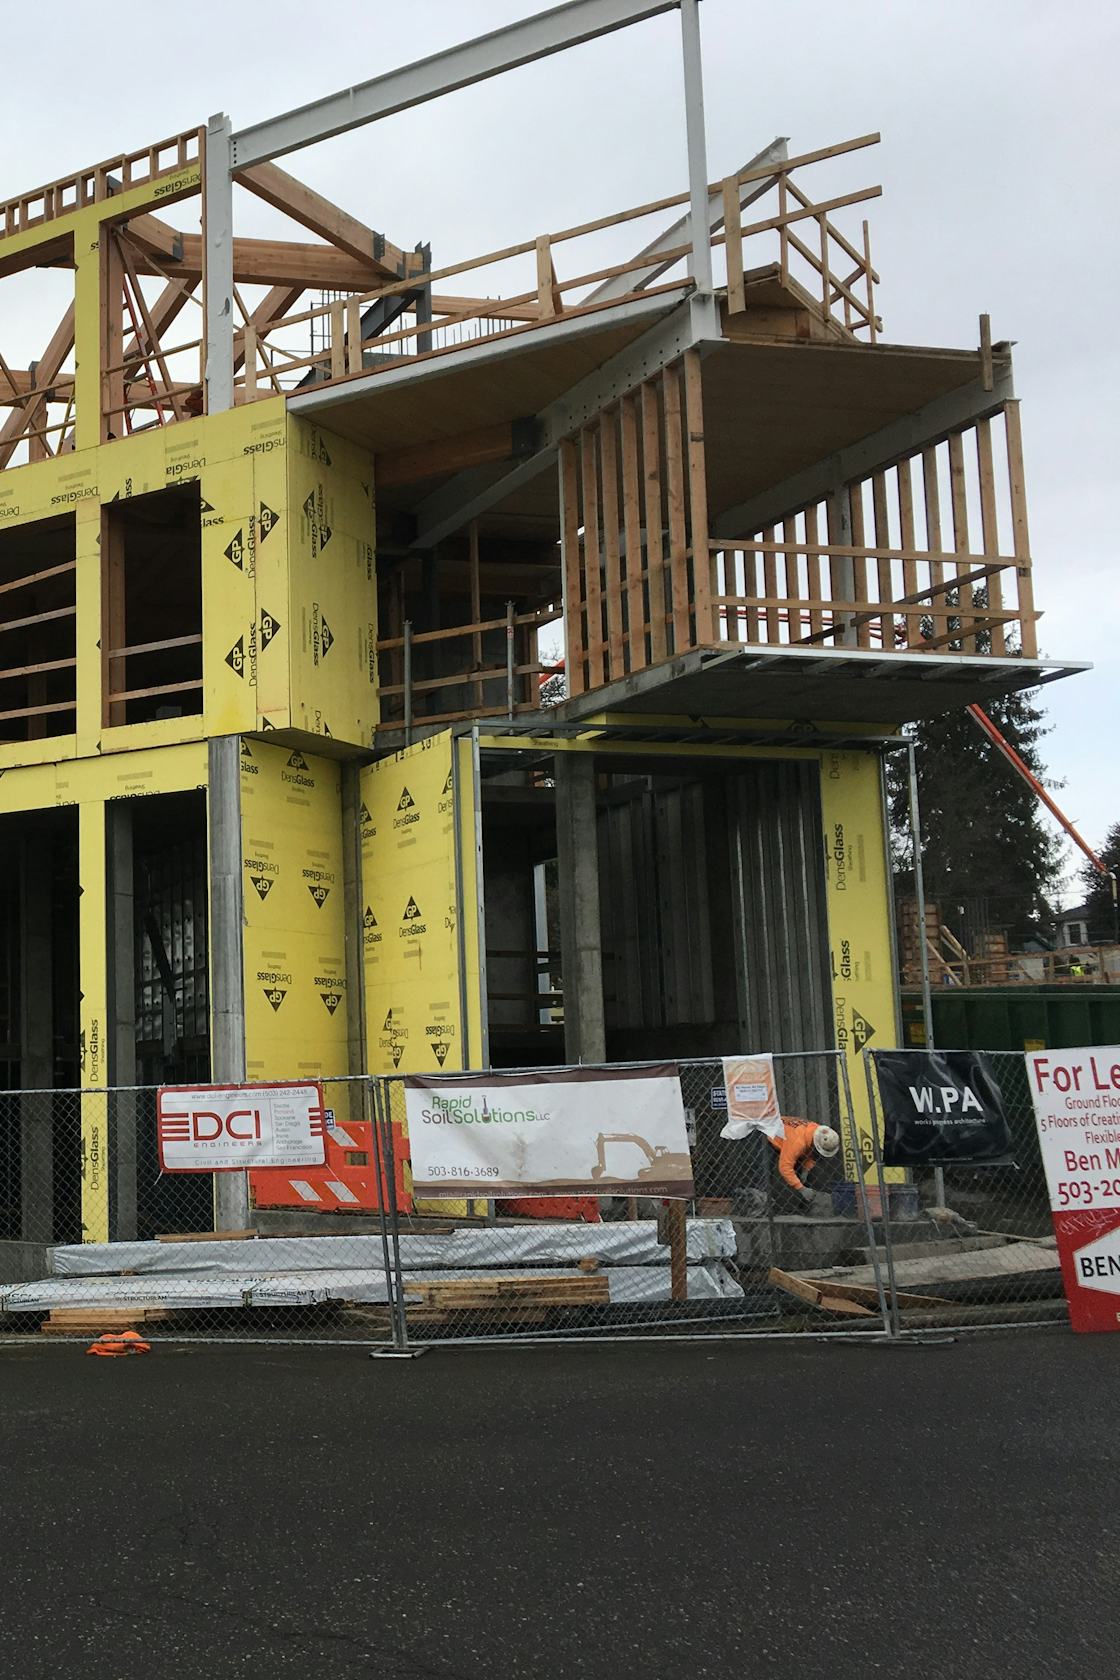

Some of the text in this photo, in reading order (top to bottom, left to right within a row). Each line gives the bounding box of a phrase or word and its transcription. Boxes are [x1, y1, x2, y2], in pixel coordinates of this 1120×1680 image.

[51, 486, 100, 505] DensGlass
[261, 509, 272, 531] GP
[232, 540, 241, 563] GP
[248, 515, 256, 579] DensGlass
[262, 616, 272, 639] GP
[322, 625, 329, 649] GP
[232, 646, 243, 670] GP
[291, 755, 304, 766] GP
[281, 770, 315, 788] DensGlass
[400, 796, 411, 807] GP
[393, 812, 420, 829] DensGlass
[836, 823, 846, 891] DensGlass
[244, 859, 279, 875] DensGlass
[302, 869, 335, 884] DensGlass
[256, 881, 270, 891] GP
[314, 890, 326, 900] GP
[406, 905, 417, 917] GP
[399, 923, 426, 938] DensGlass
[257, 972, 292, 985] DensGlass
[314, 976, 347, 990] DensGlass
[270, 992, 282, 1001] GP
[325, 995, 338, 1007] GP
[426, 1025, 454, 1036] DensGlass
[855, 1018, 865, 1044] GP
[90, 1019, 98, 1081] DensGlass
[436, 1046, 447, 1057] GP
[1033, 1058, 1083, 1092] For
[432, 1096, 472, 1112] Rapid
[908, 1086, 984, 1113] W.PA
[1065, 1095, 1101, 1110] Ground
[1041, 1119, 1047, 1132] 5
[1048, 1115, 1078, 1128] Floors
[1080, 1113, 1090, 1126] of
[91, 1126, 99, 1190] DensGlass
[1064, 1150, 1102, 1172] Ben
